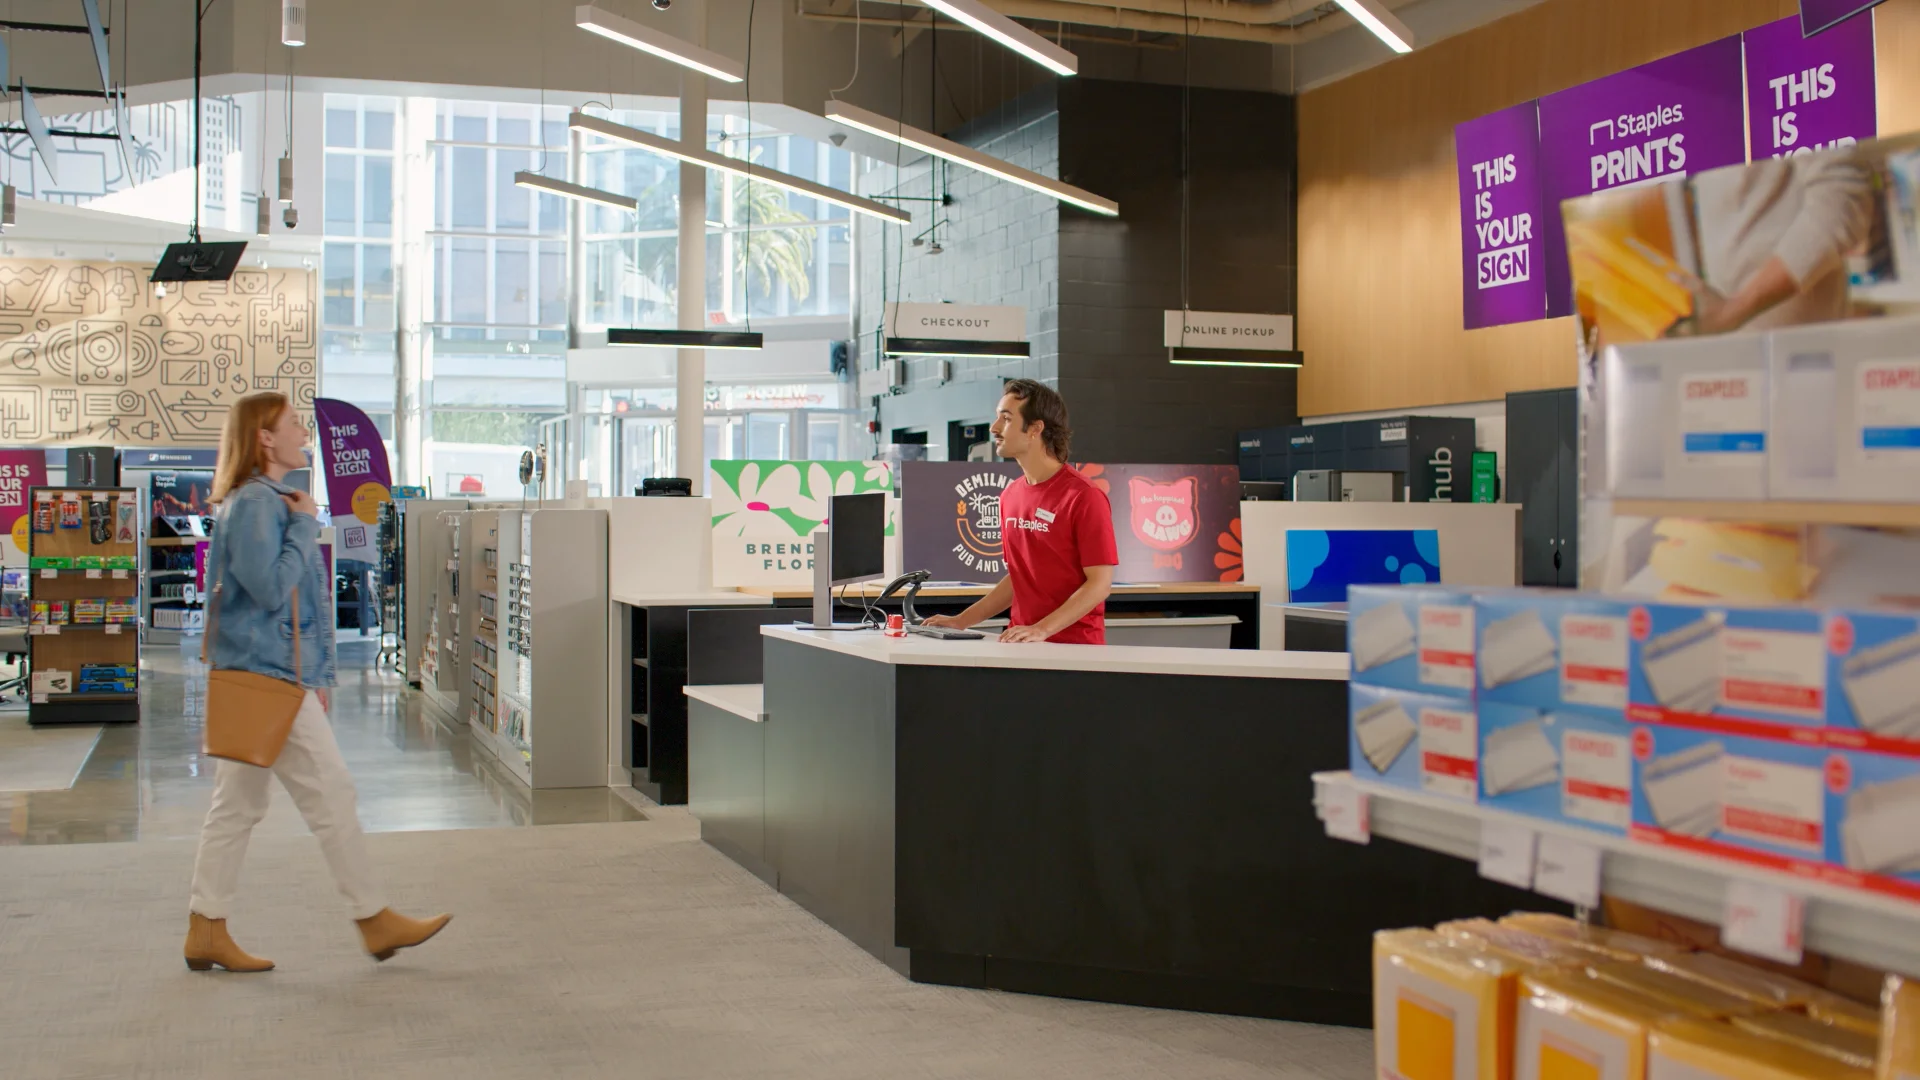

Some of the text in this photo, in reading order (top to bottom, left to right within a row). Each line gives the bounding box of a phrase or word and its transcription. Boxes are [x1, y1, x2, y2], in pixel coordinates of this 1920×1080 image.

[1769, 63, 1836, 110] THIS
[1772, 111, 1799, 149] IS
[1591, 133, 1686, 189] PRINTS
[1472, 154, 1517, 190] THIS
[1475, 191, 1493, 220] IS
[1475, 213, 1533, 249] YOUR
[1480, 249, 1527, 284] SIGN
[921, 317, 991, 328] CHECKOUT
[1183, 324, 1275, 338] ONLINE PICKUP
[1864, 368, 1920, 391] STAPL
[329, 424, 358, 437] THIS
[332, 438, 344, 450] IS
[333, 448, 371, 462] YOUR
[14, 464, 30, 477] IS
[335, 461, 369, 475] SIGN
[1429, 447, 1452, 502] hub
[0, 477, 23, 490] UR
[0, 493, 18, 504] GN
[982, 531, 1002, 539] 2022
[1142, 518, 1191, 542] HAWG
[746, 543, 814, 554] BREND
[764, 559, 814, 570] FLOR
[952, 543, 974, 567] PUB
[975, 559, 999, 573] AND
